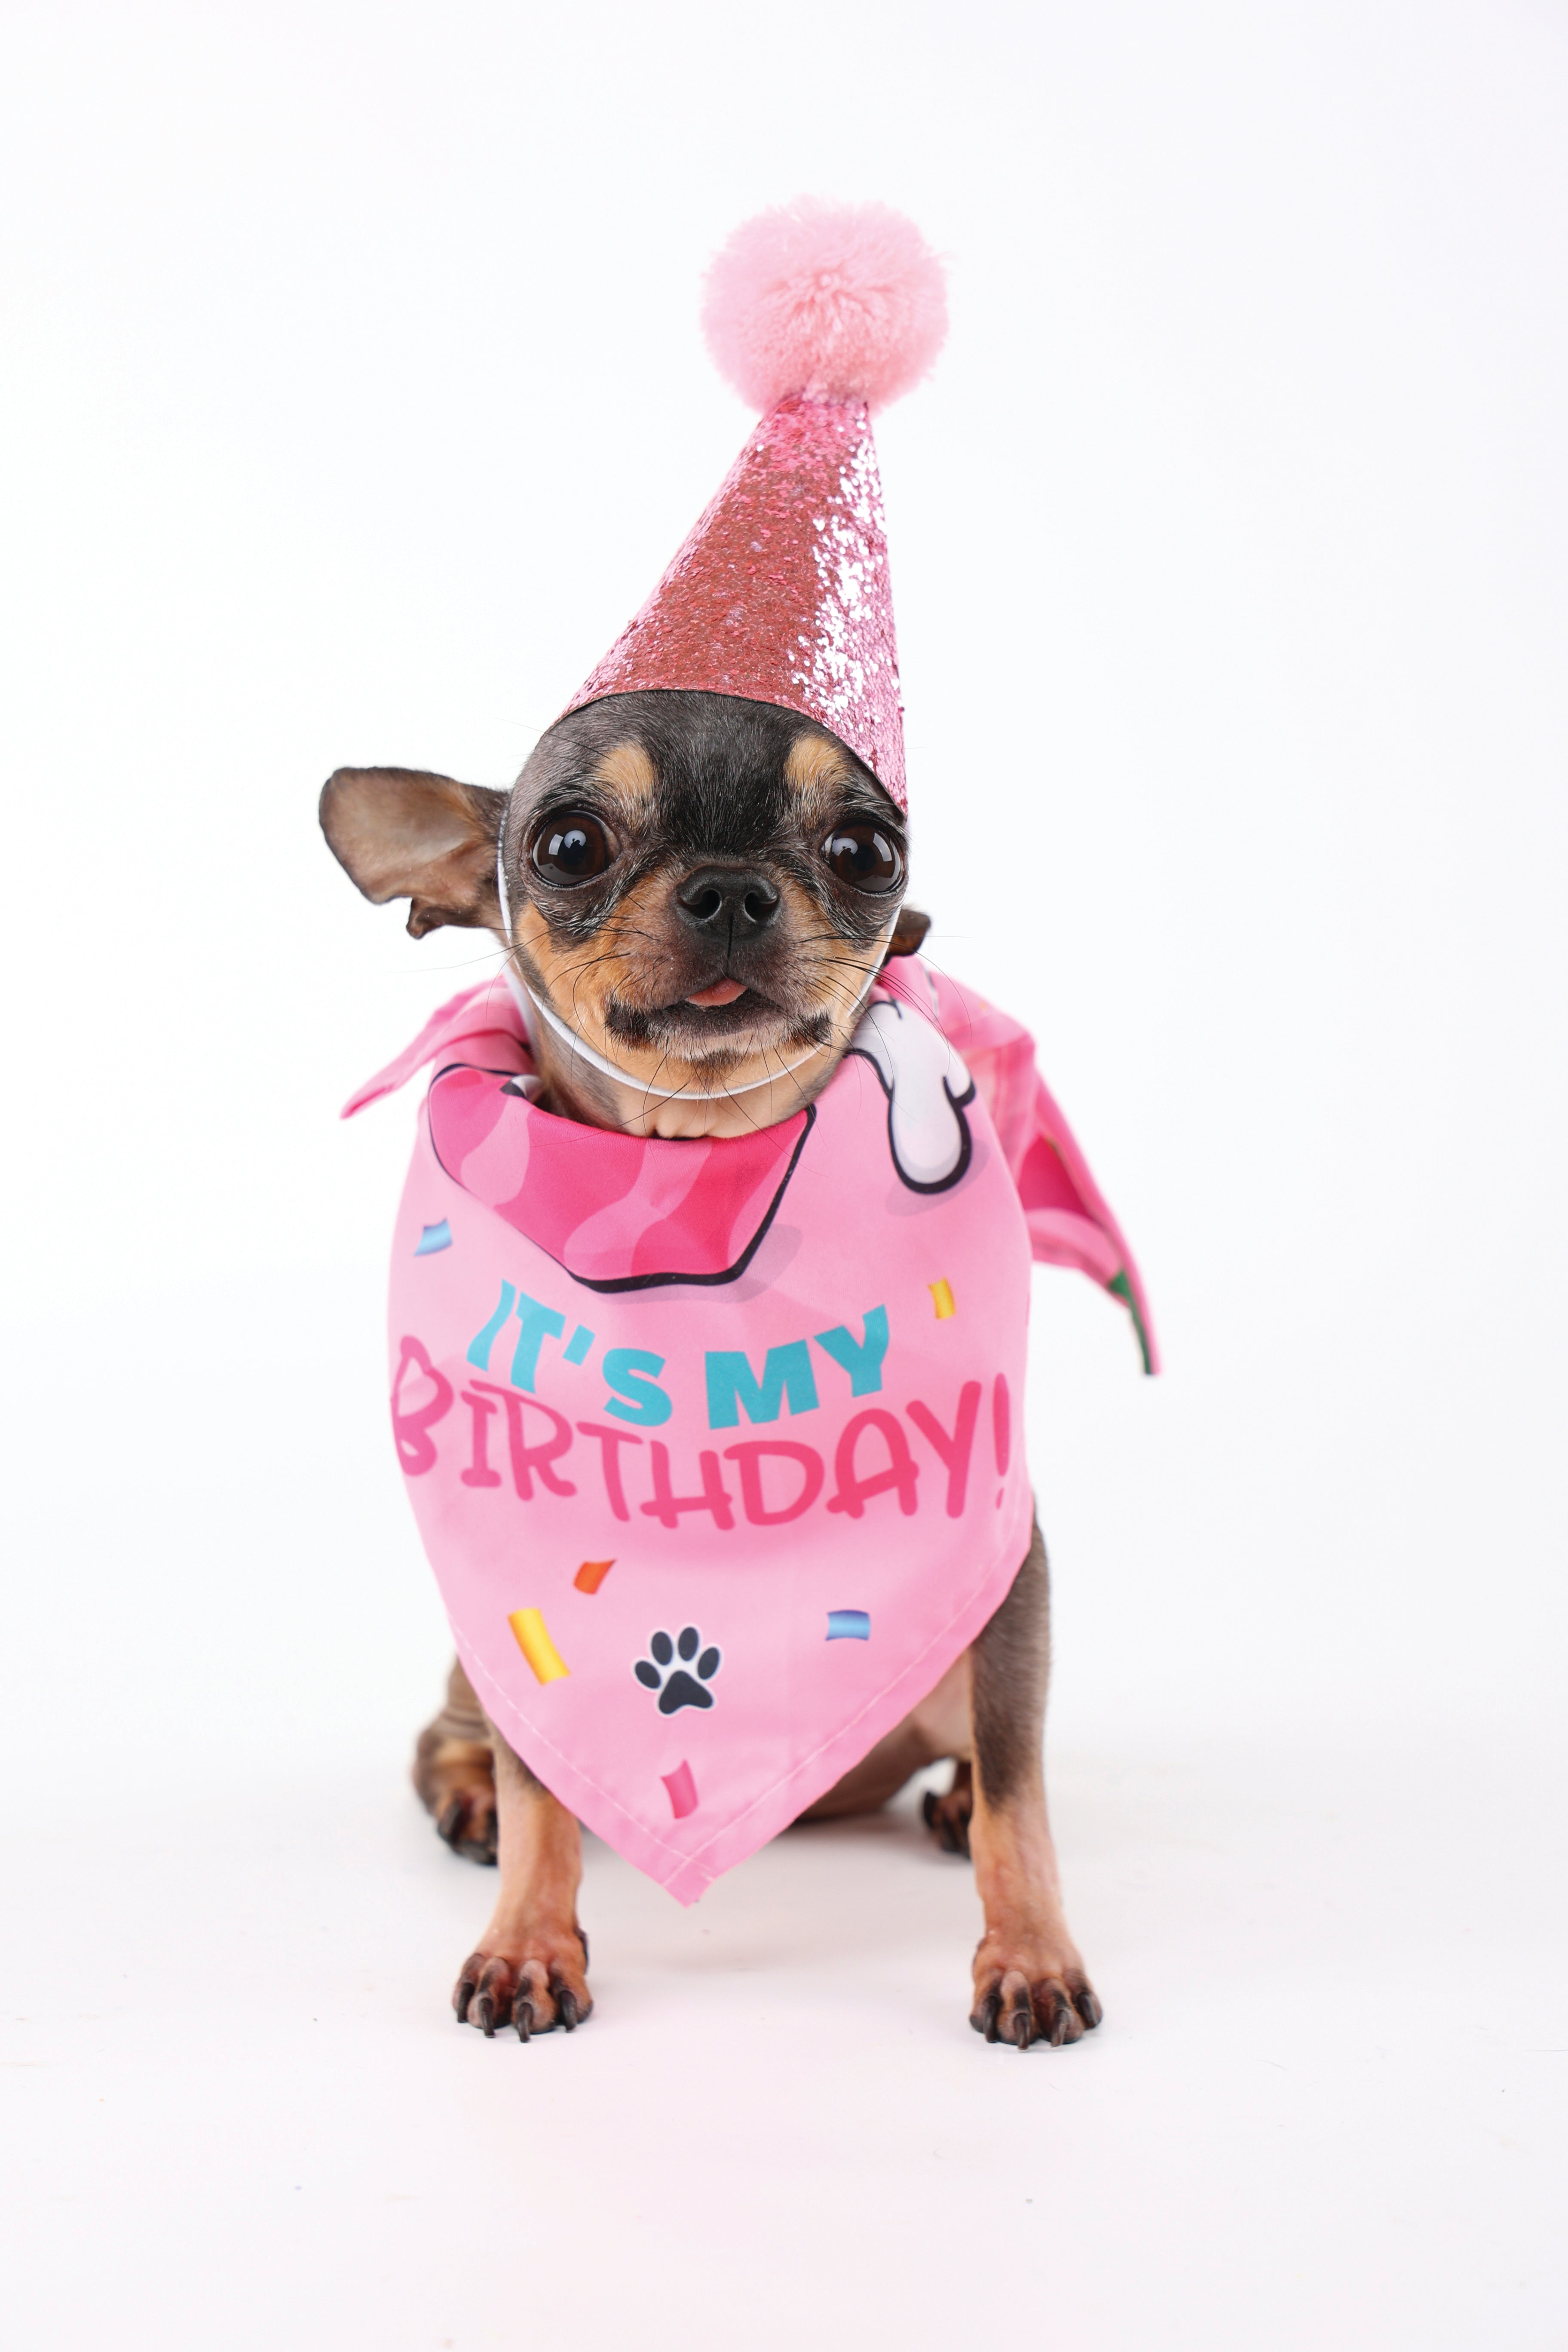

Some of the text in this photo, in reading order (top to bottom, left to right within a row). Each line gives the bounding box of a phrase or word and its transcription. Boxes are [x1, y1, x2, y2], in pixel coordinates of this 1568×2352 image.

[390, 1335, 1011, 1530] BIRTHDAY!
[466, 1278, 890, 1430] IT'S MY
